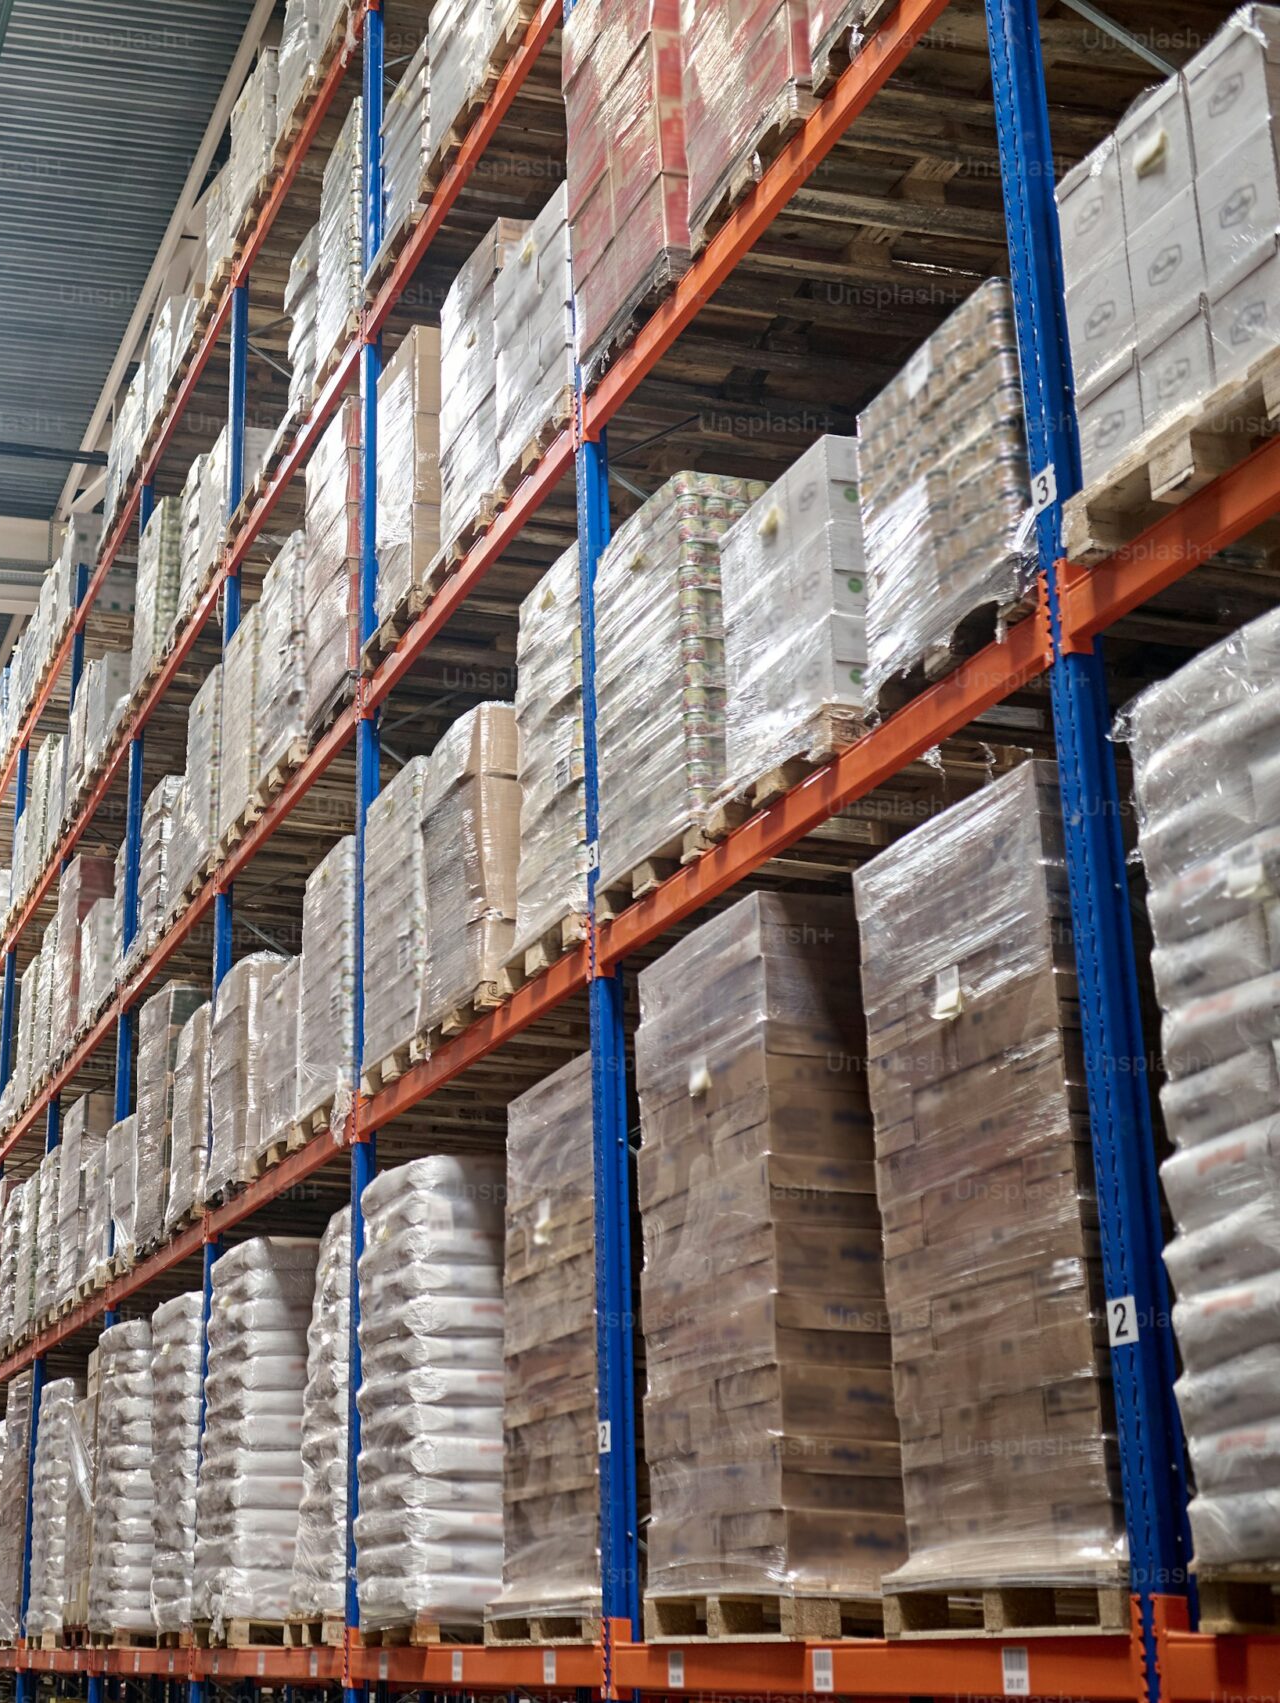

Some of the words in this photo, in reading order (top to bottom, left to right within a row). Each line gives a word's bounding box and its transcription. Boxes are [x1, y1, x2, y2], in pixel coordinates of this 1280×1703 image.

[1037, 475, 1049, 505] 3
[589, 847, 595, 867] 3
[1113, 1303, 1129, 1338] 2
[601, 1425, 608, 1448] 2
